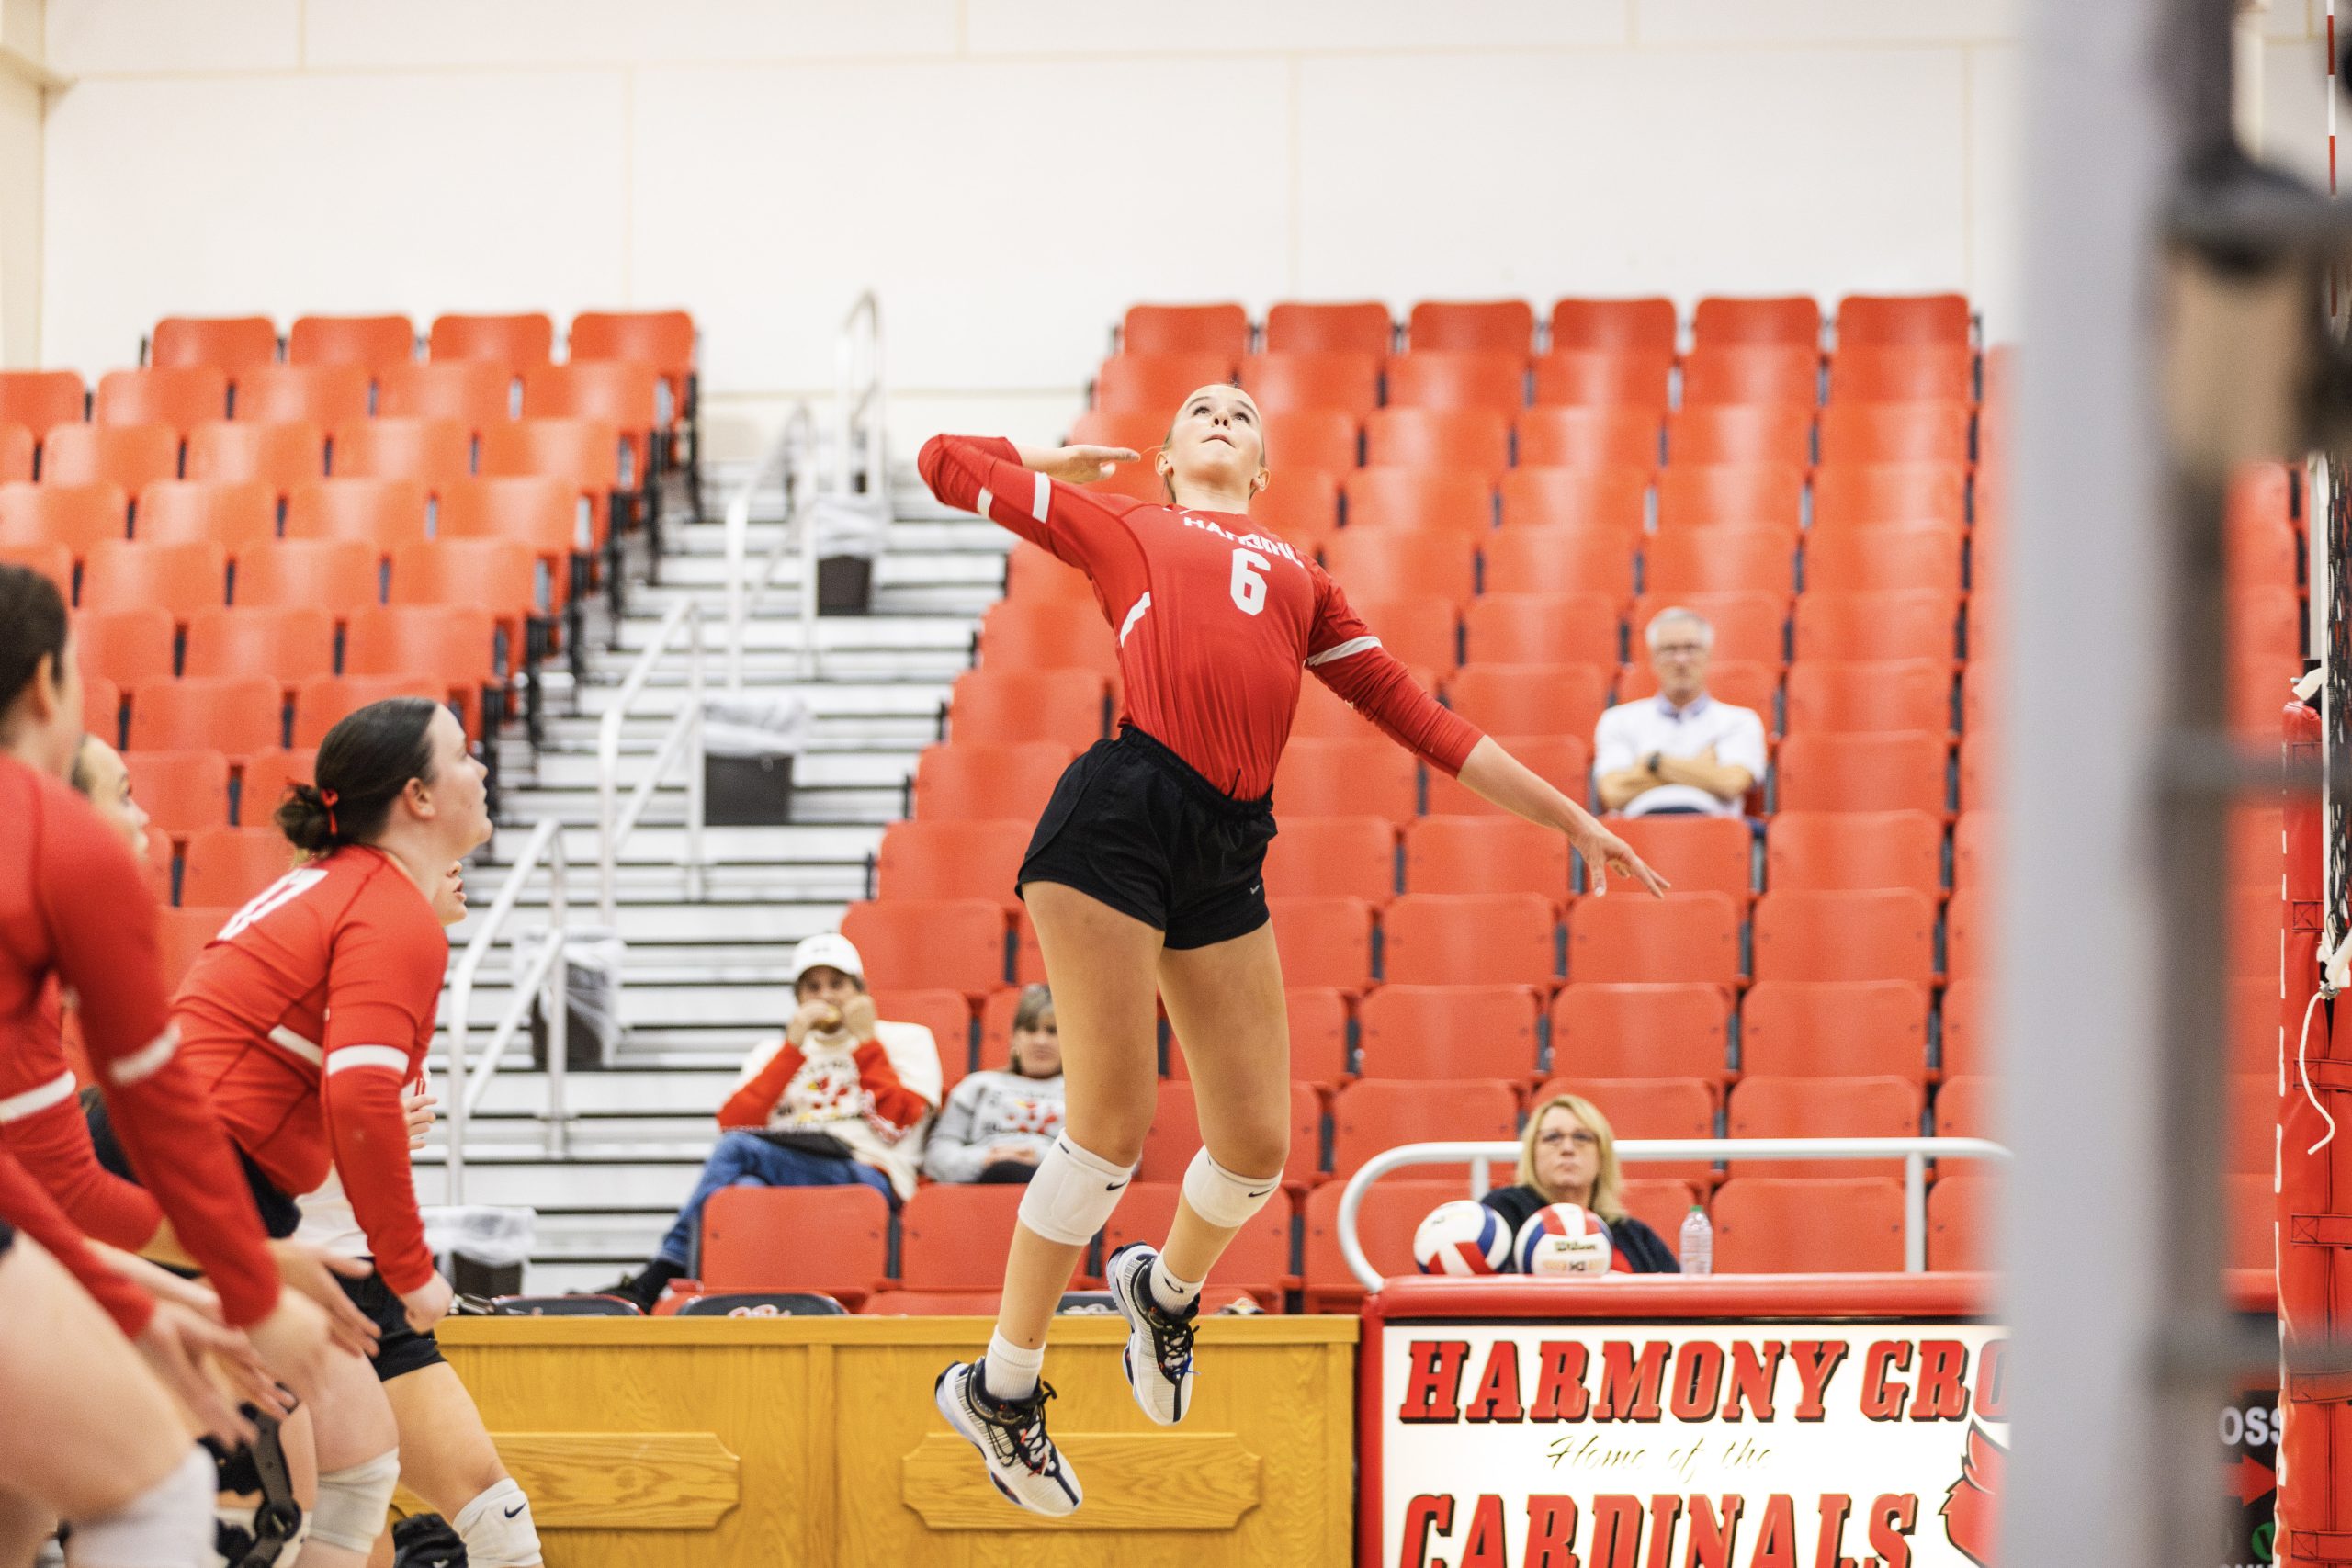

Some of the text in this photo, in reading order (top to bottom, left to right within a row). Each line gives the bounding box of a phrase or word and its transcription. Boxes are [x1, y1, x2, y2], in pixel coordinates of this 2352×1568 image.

[1230, 548, 1271, 615] 6
[1399, 1340, 1849, 1423] HARMONY
[1547, 1435, 1770, 1484] Home of the
[1400, 1494, 1917, 1568] CARDINALS
